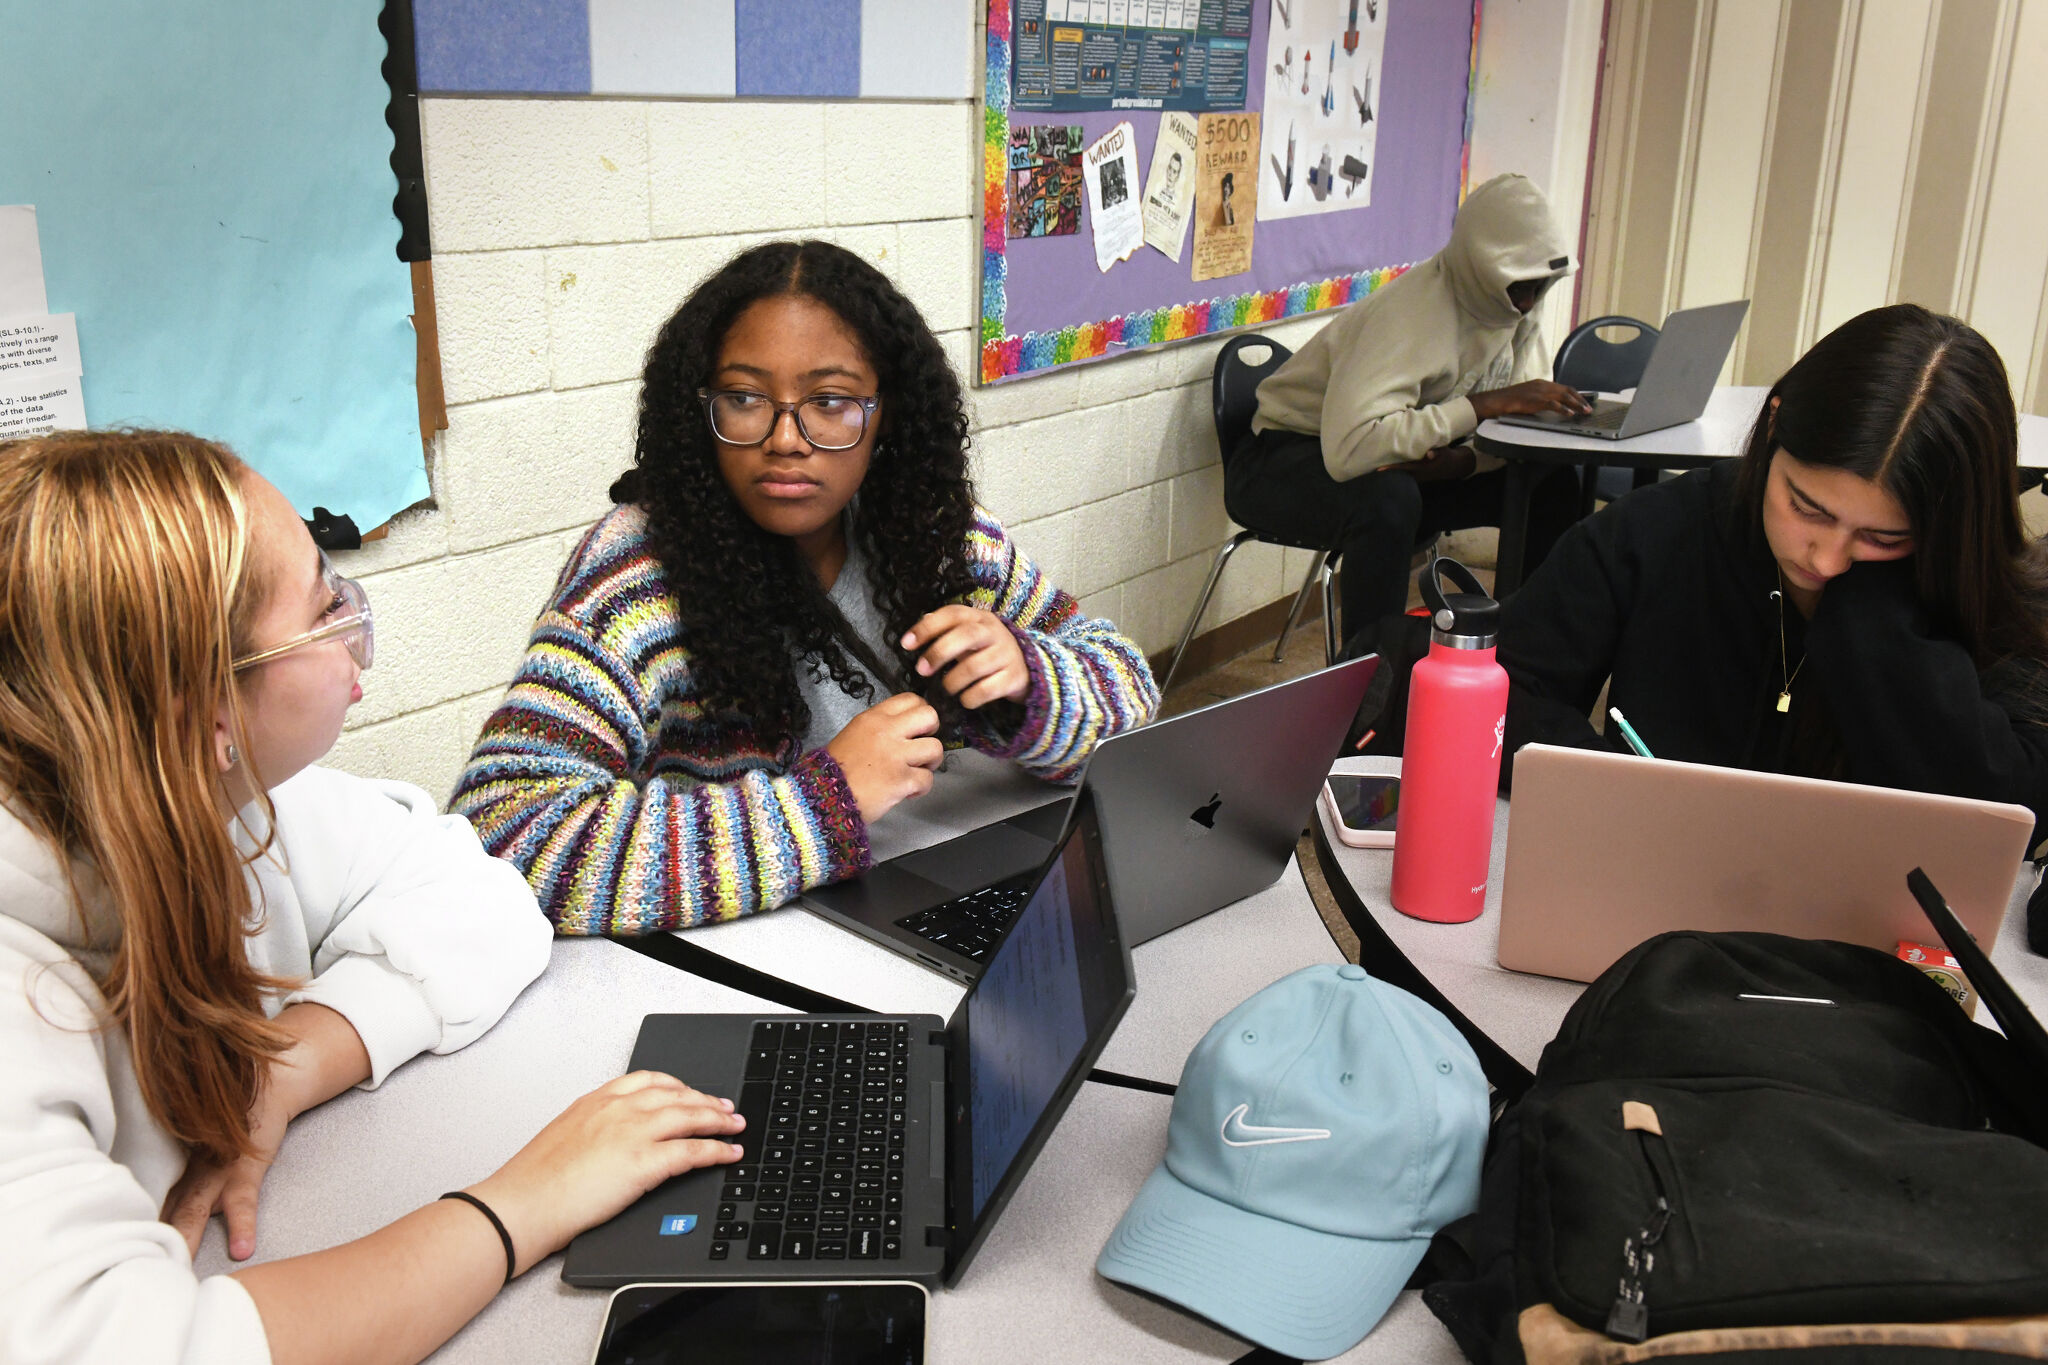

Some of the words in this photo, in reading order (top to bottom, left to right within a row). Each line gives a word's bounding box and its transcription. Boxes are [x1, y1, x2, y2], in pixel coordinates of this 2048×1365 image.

[1169, 114, 1198, 151] WANTED
[1205, 118, 1250, 149] $500
[1088, 129, 1125, 167] WANTED
[1205, 151, 1248, 169] REWARD
[0, 339, 23, 348] tively
[40, 334, 59, 343] range
[7, 349, 25, 358] with
[26, 346, 52, 356] diverse
[23, 359, 45, 367] texts,
[45, 355, 57, 364] and
[21, 395, 37, 403] Use
[39, 389, 68, 401] statistics
[0, 408, 9, 417] of
[25, 405, 44, 413] data
